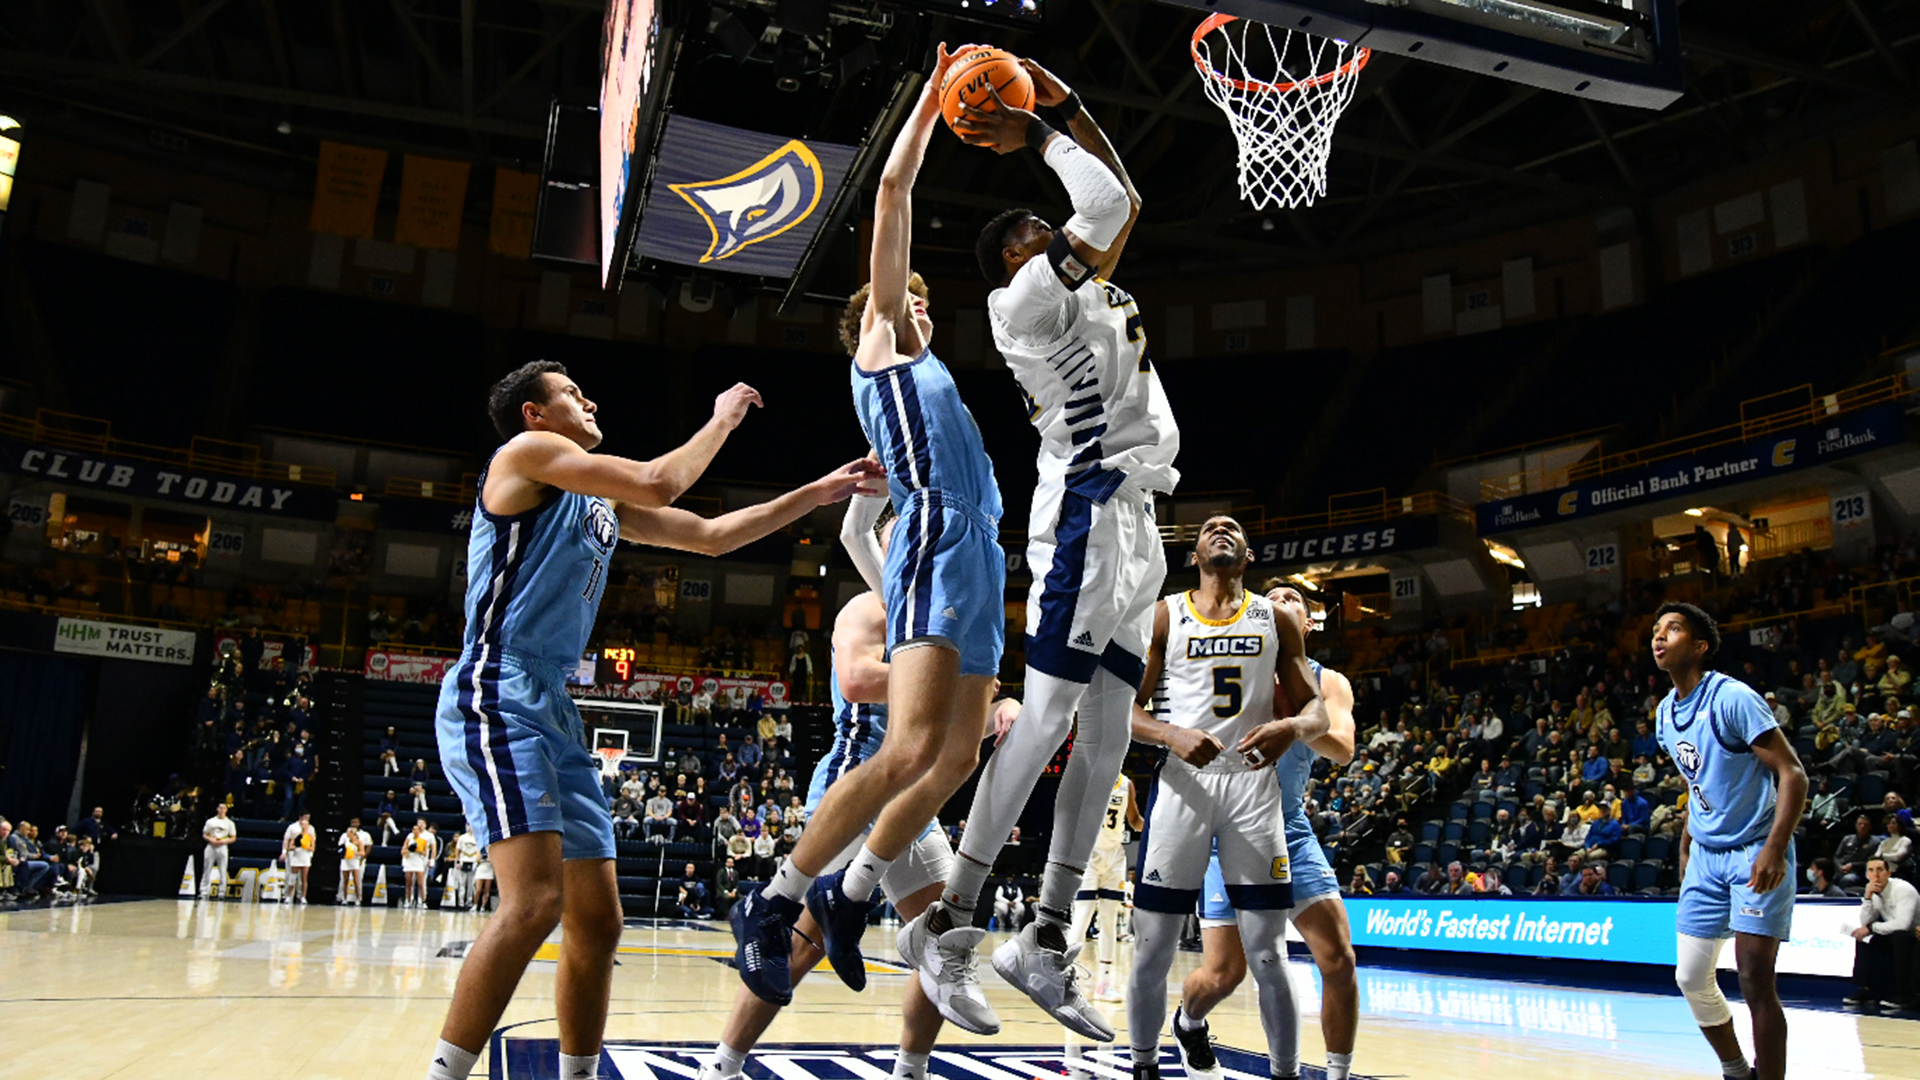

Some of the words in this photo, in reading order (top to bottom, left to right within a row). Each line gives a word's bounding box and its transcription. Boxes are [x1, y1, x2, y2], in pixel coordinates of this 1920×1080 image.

[20, 449, 135, 488] CLUB
[156, 470, 293, 511] TODAY
[1590, 479, 1645, 507] Official
[1649, 468, 1690, 494] Bank
[1693, 457, 1759, 484] Partner
[10, 503, 42, 524] 205
[1836, 497, 1865, 521] 213
[212, 532, 242, 551] 206
[1261, 527, 1396, 563] SUCCESS
[1589, 547, 1615, 567] 212
[683, 581, 709, 598] 208
[1395, 579, 1414, 596] 211
[58, 623, 101, 641] HHM
[108, 627, 163, 643] TRUST
[106, 641, 191, 661] MATTERS.
[1188, 637, 1261, 657] MOCS
[615, 660, 628, 680] 9
[1212, 666, 1243, 718] 5
[1366, 908, 1432, 937] World's
[1434, 910, 1510, 940] Fastest
[1513, 912, 1613, 945] Internet
